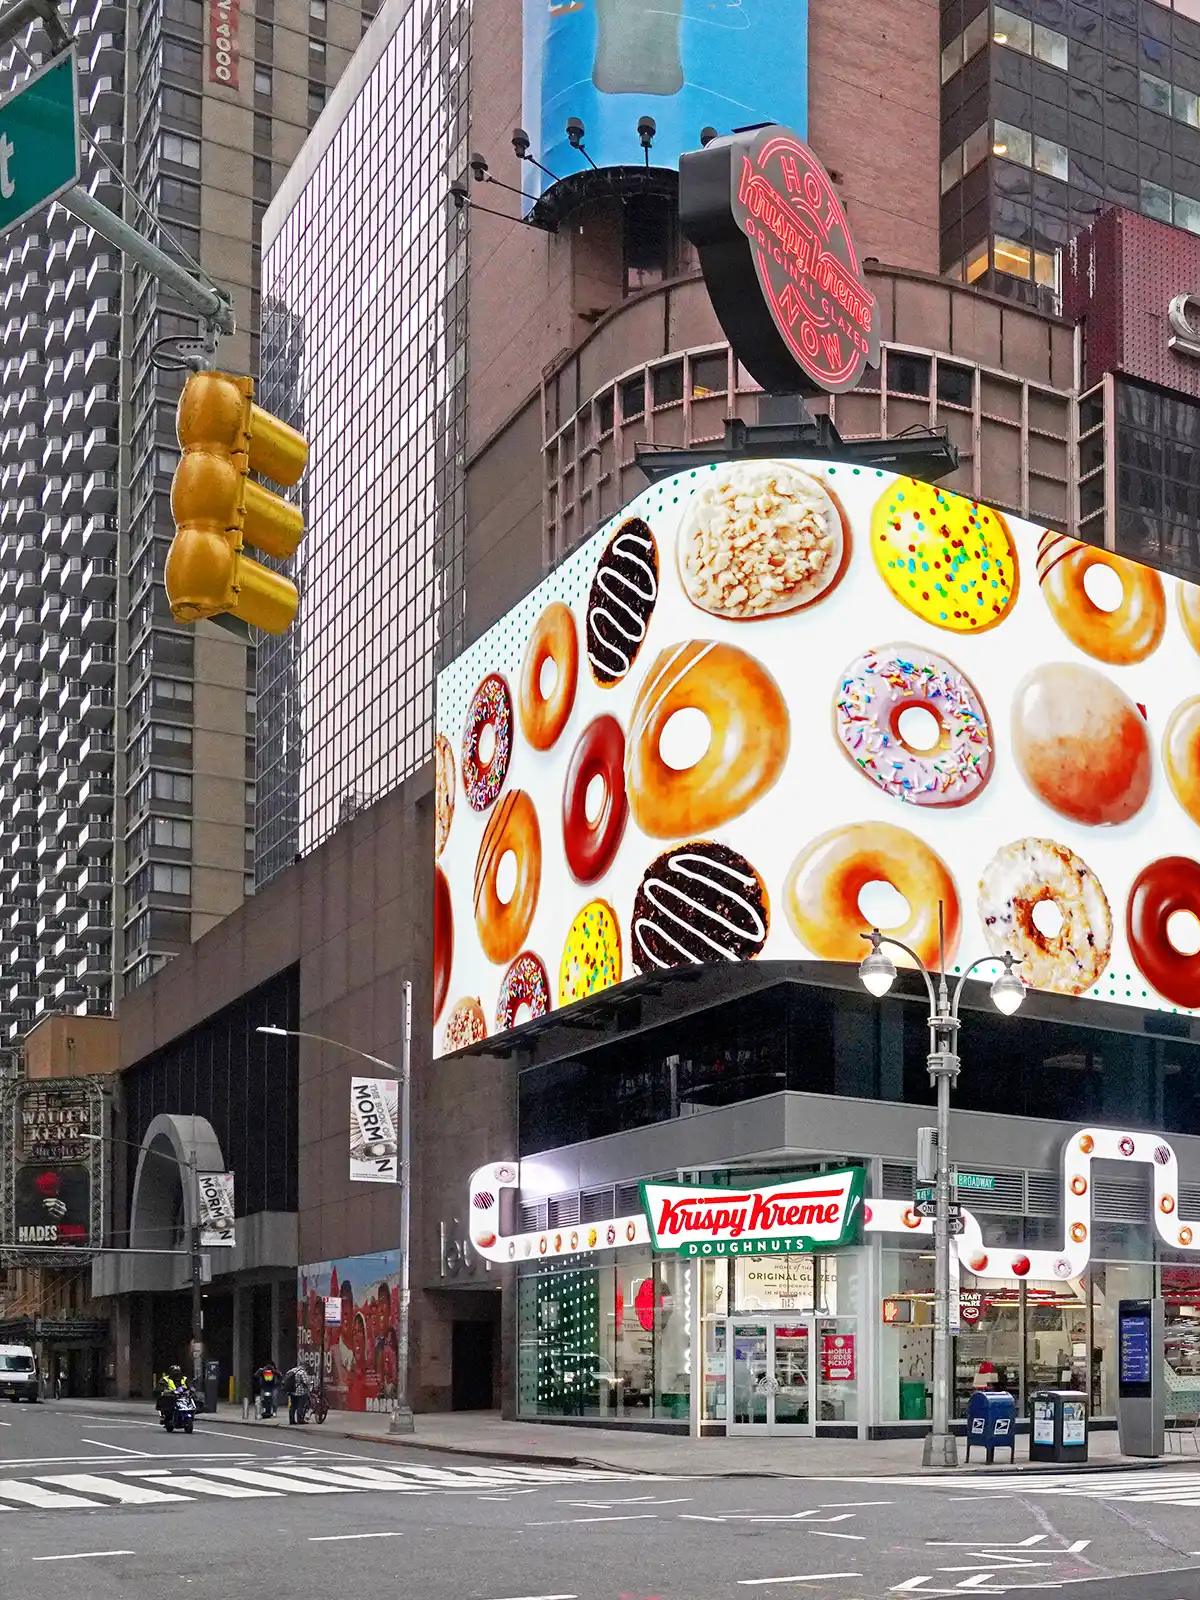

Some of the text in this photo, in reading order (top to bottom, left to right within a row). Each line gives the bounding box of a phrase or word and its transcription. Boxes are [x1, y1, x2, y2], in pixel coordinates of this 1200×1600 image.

[781, 156, 839, 231] HOT
[746, 218, 869, 354] ORIGINAL GLAZED
[779, 284, 842, 369] NOW
[32, 1127, 79, 1141] KERR
[959, 1175, 993, 1188] BROADWAY
[657, 1188, 844, 1237] Krispy Kreme
[689, 1239, 804, 1255] DOUGHNUTS
[748, 1272, 837, 1282] ORIGINAL GLZED
